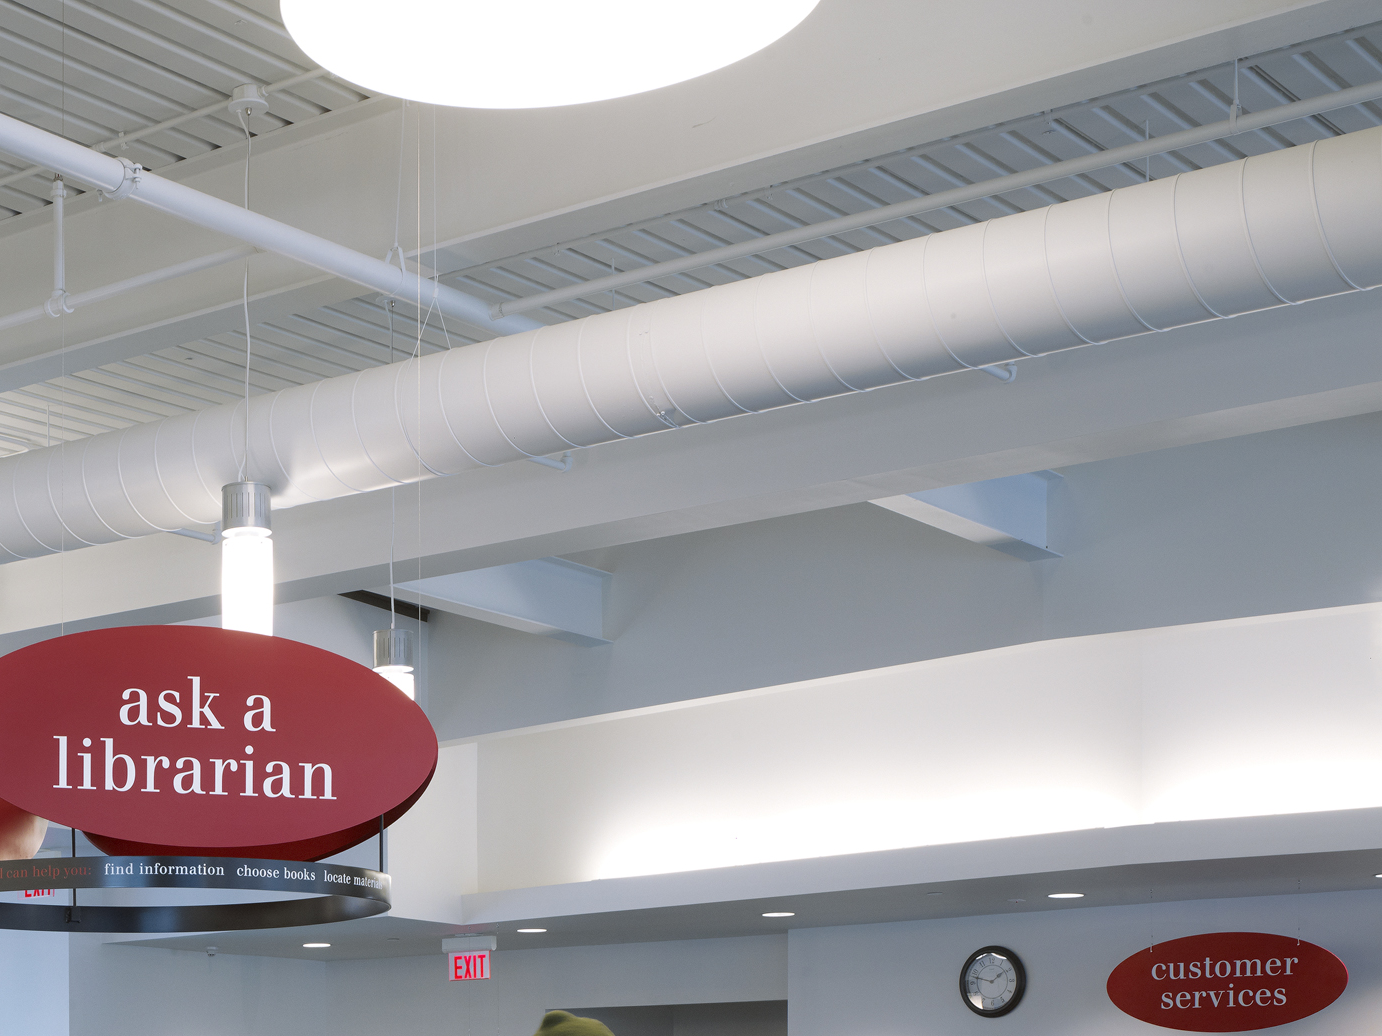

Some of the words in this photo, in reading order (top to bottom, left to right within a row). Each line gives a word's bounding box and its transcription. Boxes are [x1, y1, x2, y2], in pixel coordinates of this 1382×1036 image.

[119, 676, 225, 730] ask
[243, 692, 276, 733] a
[53, 736, 337, 800] librarian
[0, 867, 4, 879] I
[6, 869, 28, 879] can
[33, 865, 60, 879] help
[63, 867, 92, 879] you:
[104, 863, 134, 875] find
[139, 863, 225, 876] information
[236, 865, 279, 878] choose
[284, 867, 316, 881] books
[324, 870, 352, 885] locate
[353, 876, 383, 890] materials
[454, 954, 486, 979] EXIT
[1151, 957, 1299, 981] customer
[1160, 983, 1287, 1010] services
